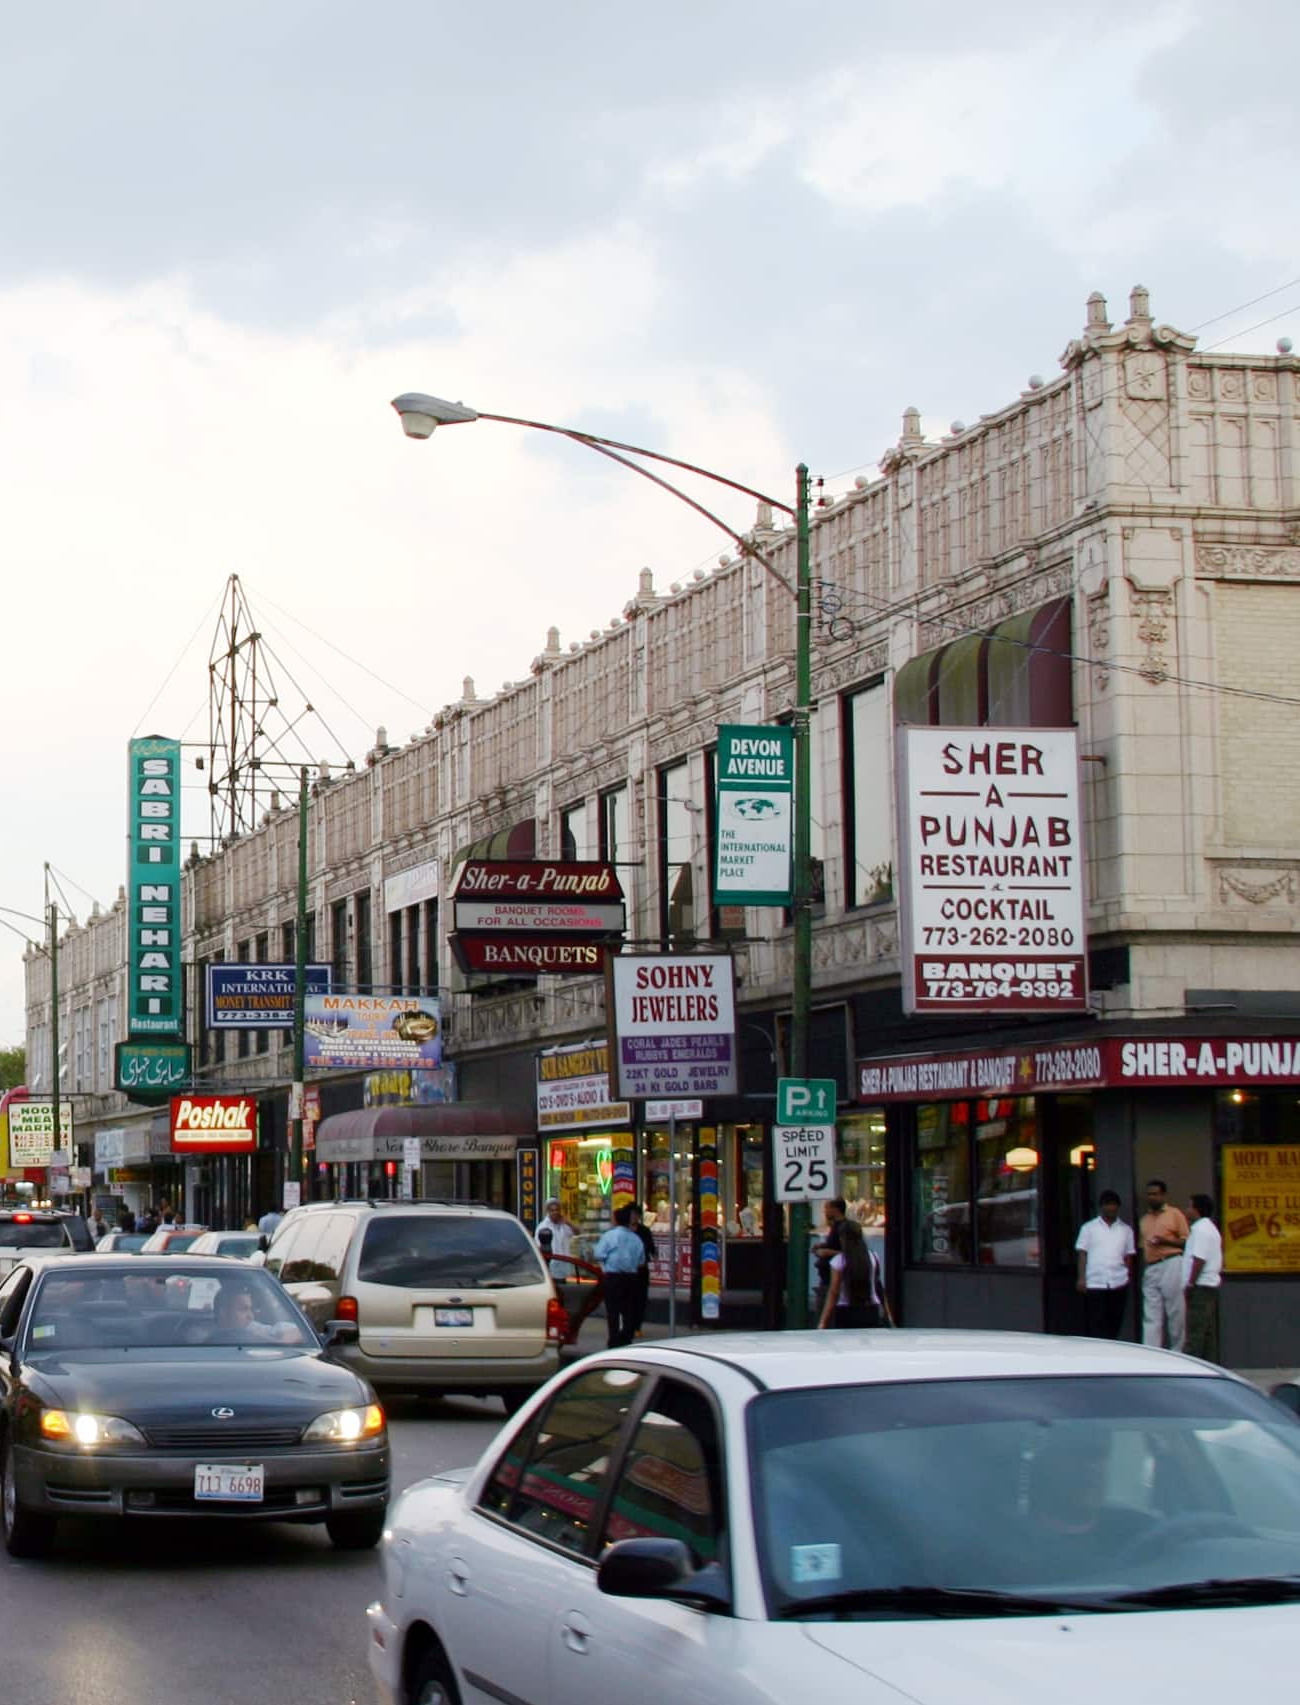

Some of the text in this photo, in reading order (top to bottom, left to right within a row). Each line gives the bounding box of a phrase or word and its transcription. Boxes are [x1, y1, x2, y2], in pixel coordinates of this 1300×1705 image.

[731, 739, 781, 756] DEVON
[727, 758, 785, 776] AVENUE
[942, 742, 1044, 776] SHER
[985, 783, 1004, 808] A
[140, 759, 171, 862] SABRI
[720, 829, 736, 839] THE
[920, 815, 1072, 848] PUNJAB
[720, 843, 786, 853] INTERNATIONAL
[720, 855, 754, 865] MARKET
[920, 854, 1073, 877] RESTAURANT
[461, 867, 610, 894] Sher-a-Punjab
[720, 868, 744, 878] PLACE
[495, 906, 587, 916] BANQUET ROOMS
[941, 898, 1054, 921] COCKTAIL
[477, 917, 604, 928] FOR ALL OCCASIONS
[922, 927, 1074, 947] 773-262-2080
[139, 885, 171, 1014] NEHARI
[484, 945, 598, 966] BANQUETS
[246, 970, 289, 981] KRK
[636, 965, 714, 990] SOHNY
[922, 963, 1076, 982] BANQUET
[221, 983, 322, 993] INTERNATIOAL
[926, 981, 1073, 998] 773-764-9392
[323, 997, 418, 1010] MAKKAH
[632, 994, 719, 1023] JEWELERS
[131, 1018, 178, 1030] Restaurant
[628, 1038, 656, 1049] CORAL
[660, 1037, 687, 1048] JADES
[626, 1066, 730, 1079] 22KT GOLD JEWELRY
[918, 1060, 969, 1091] RESTAURANT
[978, 1056, 1016, 1086] BANQUET
[1035, 1048, 1101, 1082] 773-262-2080
[665, 1081, 689, 1091] GOLD
[693, 1080, 718, 1090] BARS
[21, 1106, 54, 1115] NOO
[176, 1100, 251, 1129] Poshak
[12, 1123, 70, 1132] MARKT
[782, 1130, 824, 1143] SPEED
[785, 1145, 820, 1158] LIMIT
[784, 1160, 828, 1192] 25
[523, 1152, 533, 1219] PHONE
[1228, 1195, 1280, 1210] BUFFET
